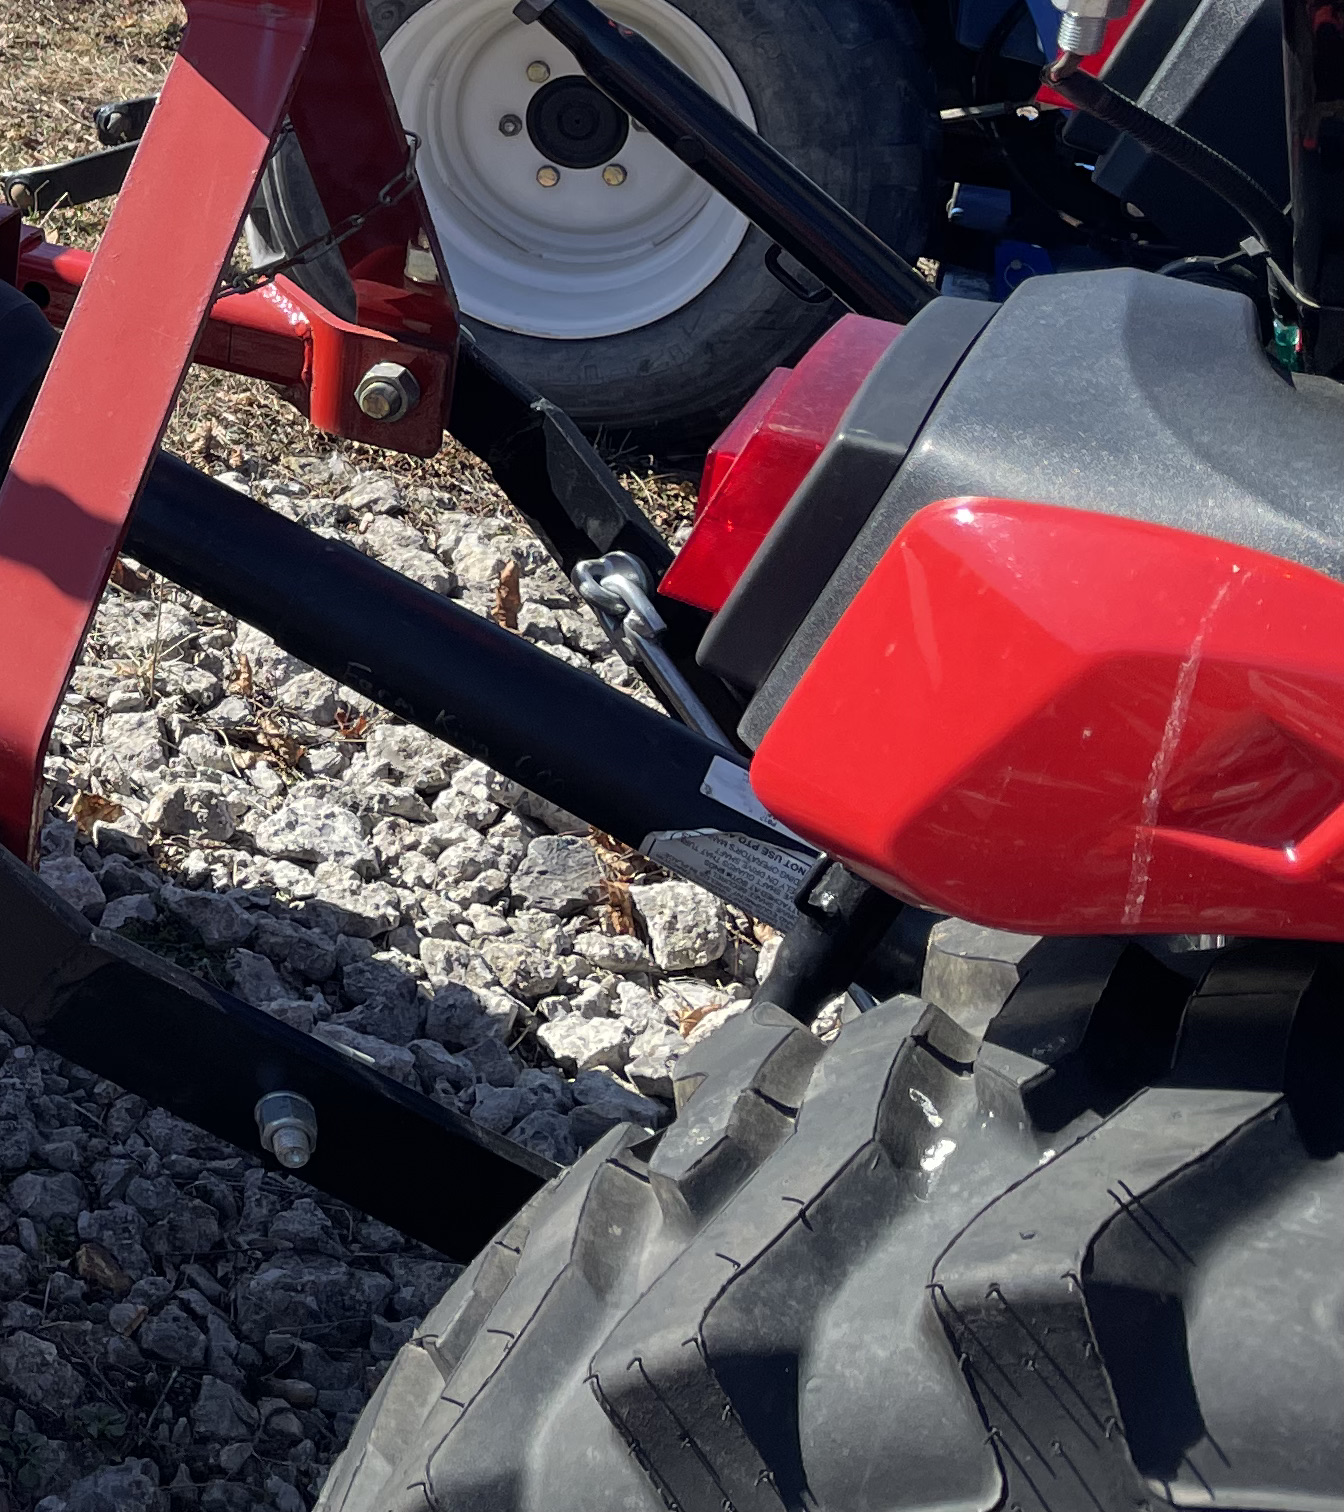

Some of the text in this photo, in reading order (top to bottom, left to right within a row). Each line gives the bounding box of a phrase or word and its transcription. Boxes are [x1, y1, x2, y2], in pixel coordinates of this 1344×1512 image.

[737, 834, 760, 851] PTO
[760, 846, 782, 863] USE
[782, 858, 807, 876] NOT
[779, 870, 800, 885] DING
